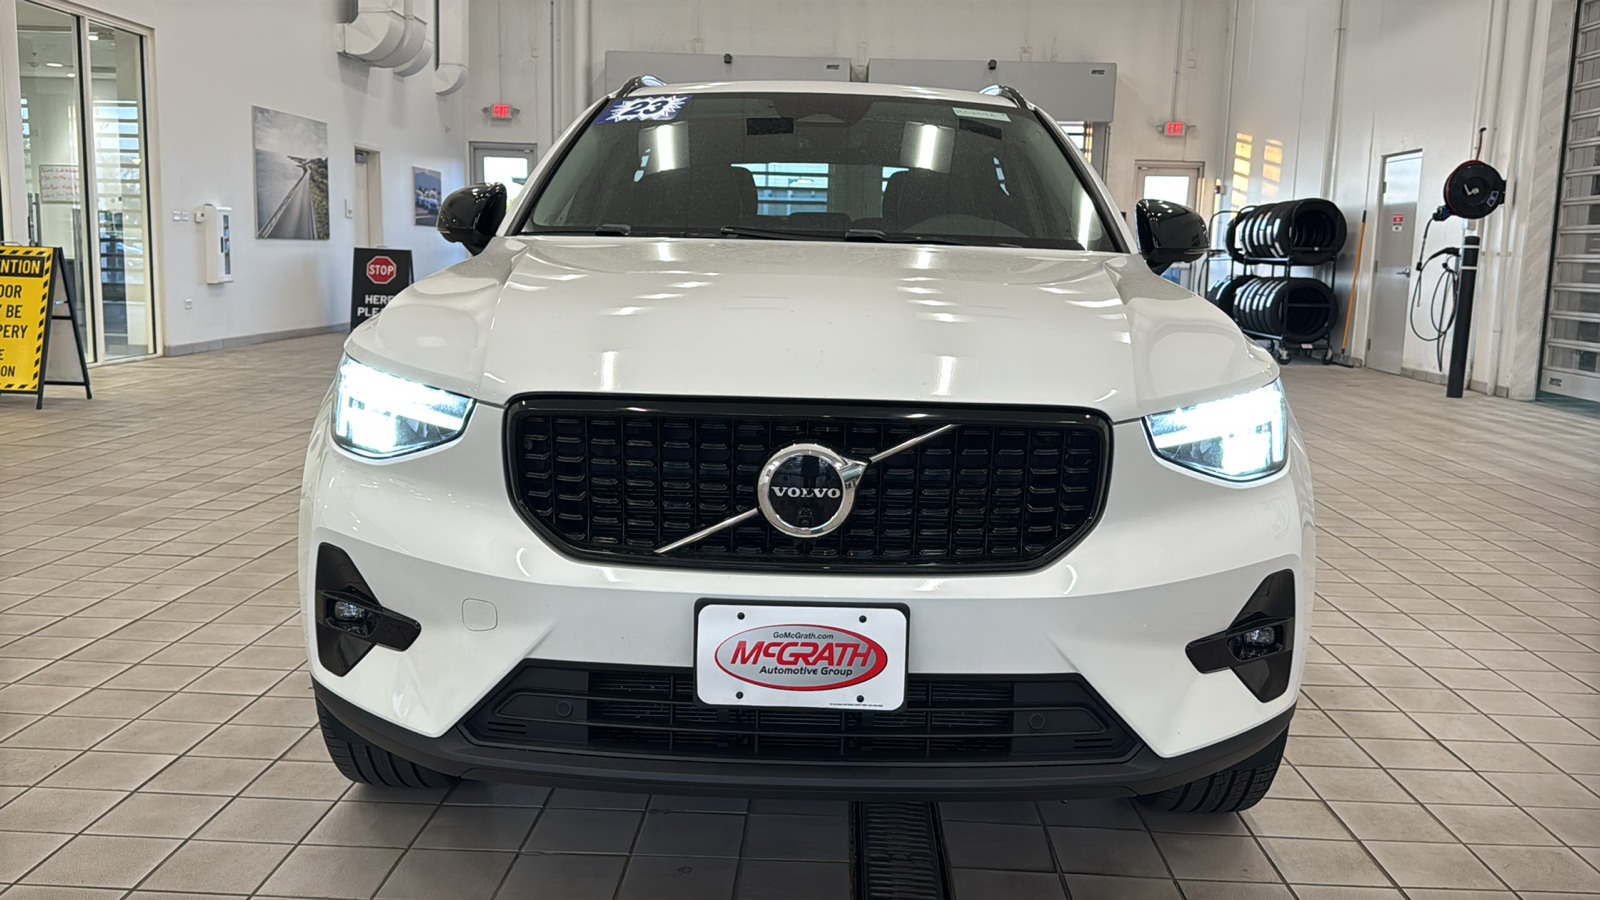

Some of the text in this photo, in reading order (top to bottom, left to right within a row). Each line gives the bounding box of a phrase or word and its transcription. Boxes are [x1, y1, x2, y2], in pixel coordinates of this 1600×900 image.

[620, 100, 669, 116] 23
[0, 258, 41, 275] NTION
[368, 264, 395, 276] STOP
[771, 486, 841, 498] VOLVO
[772, 631, 834, 640] GoMcGrath.com
[759, 665, 853, 677] Automotive Group
